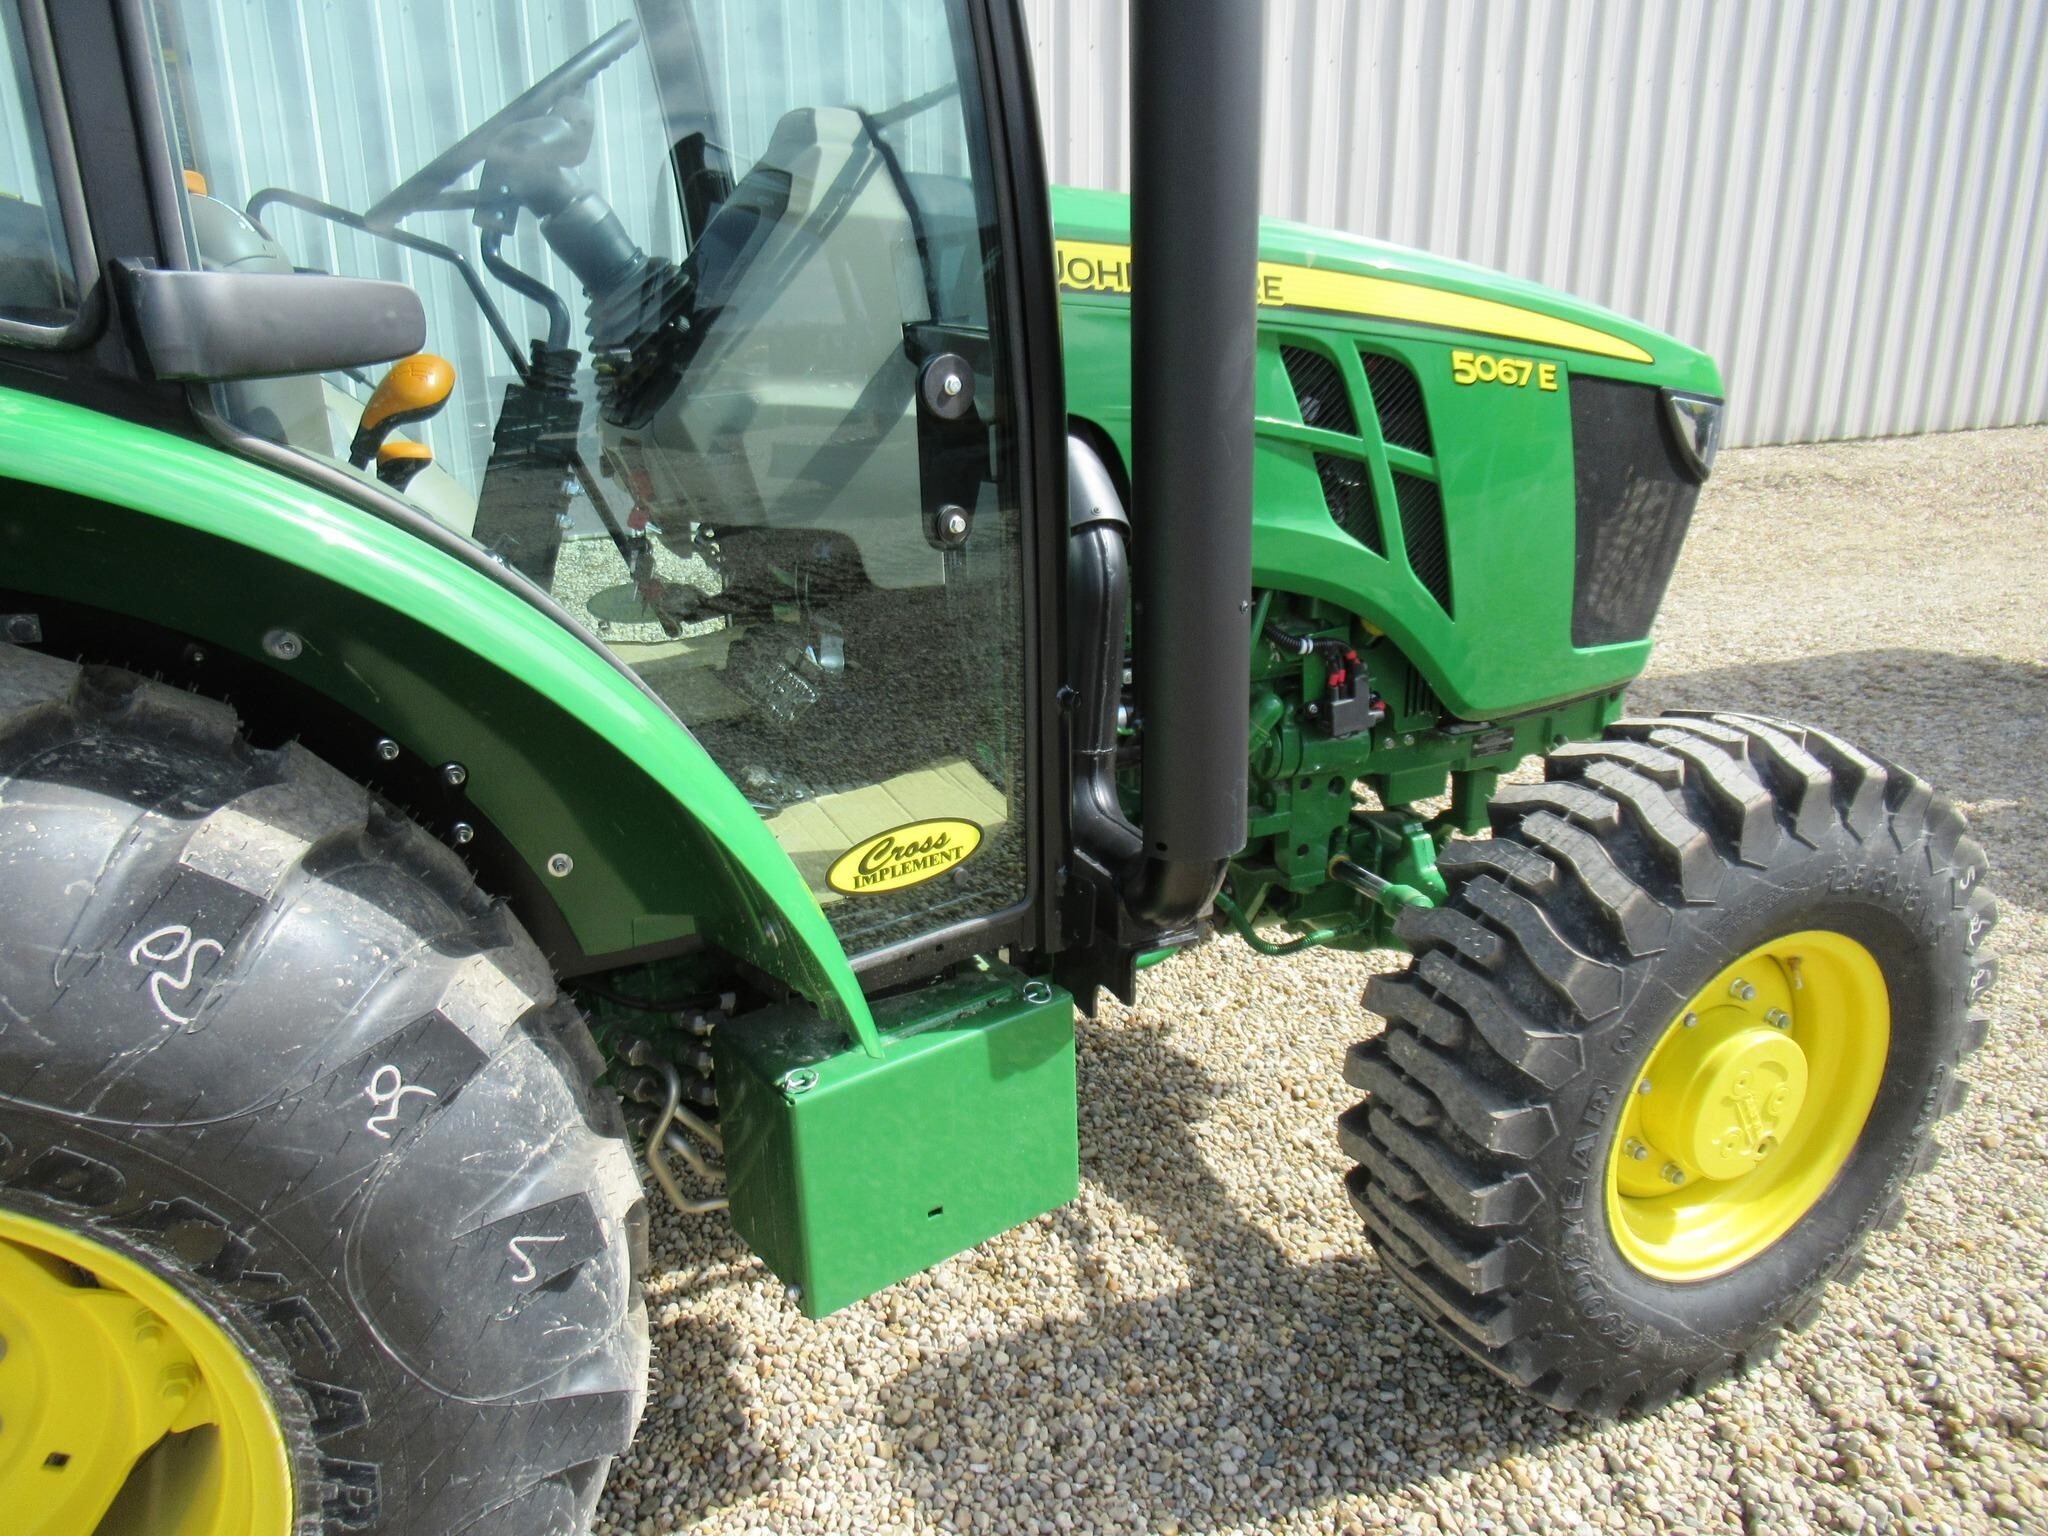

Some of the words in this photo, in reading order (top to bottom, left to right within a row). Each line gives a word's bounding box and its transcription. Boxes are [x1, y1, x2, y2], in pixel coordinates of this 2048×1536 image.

[1056, 249, 1131, 290] JOH
[1452, 350, 1533, 386] 5067
[1538, 362, 1558, 392] E
[853, 845, 964, 890] IMPLEMENT
[858, 831, 951, 875] Cross
